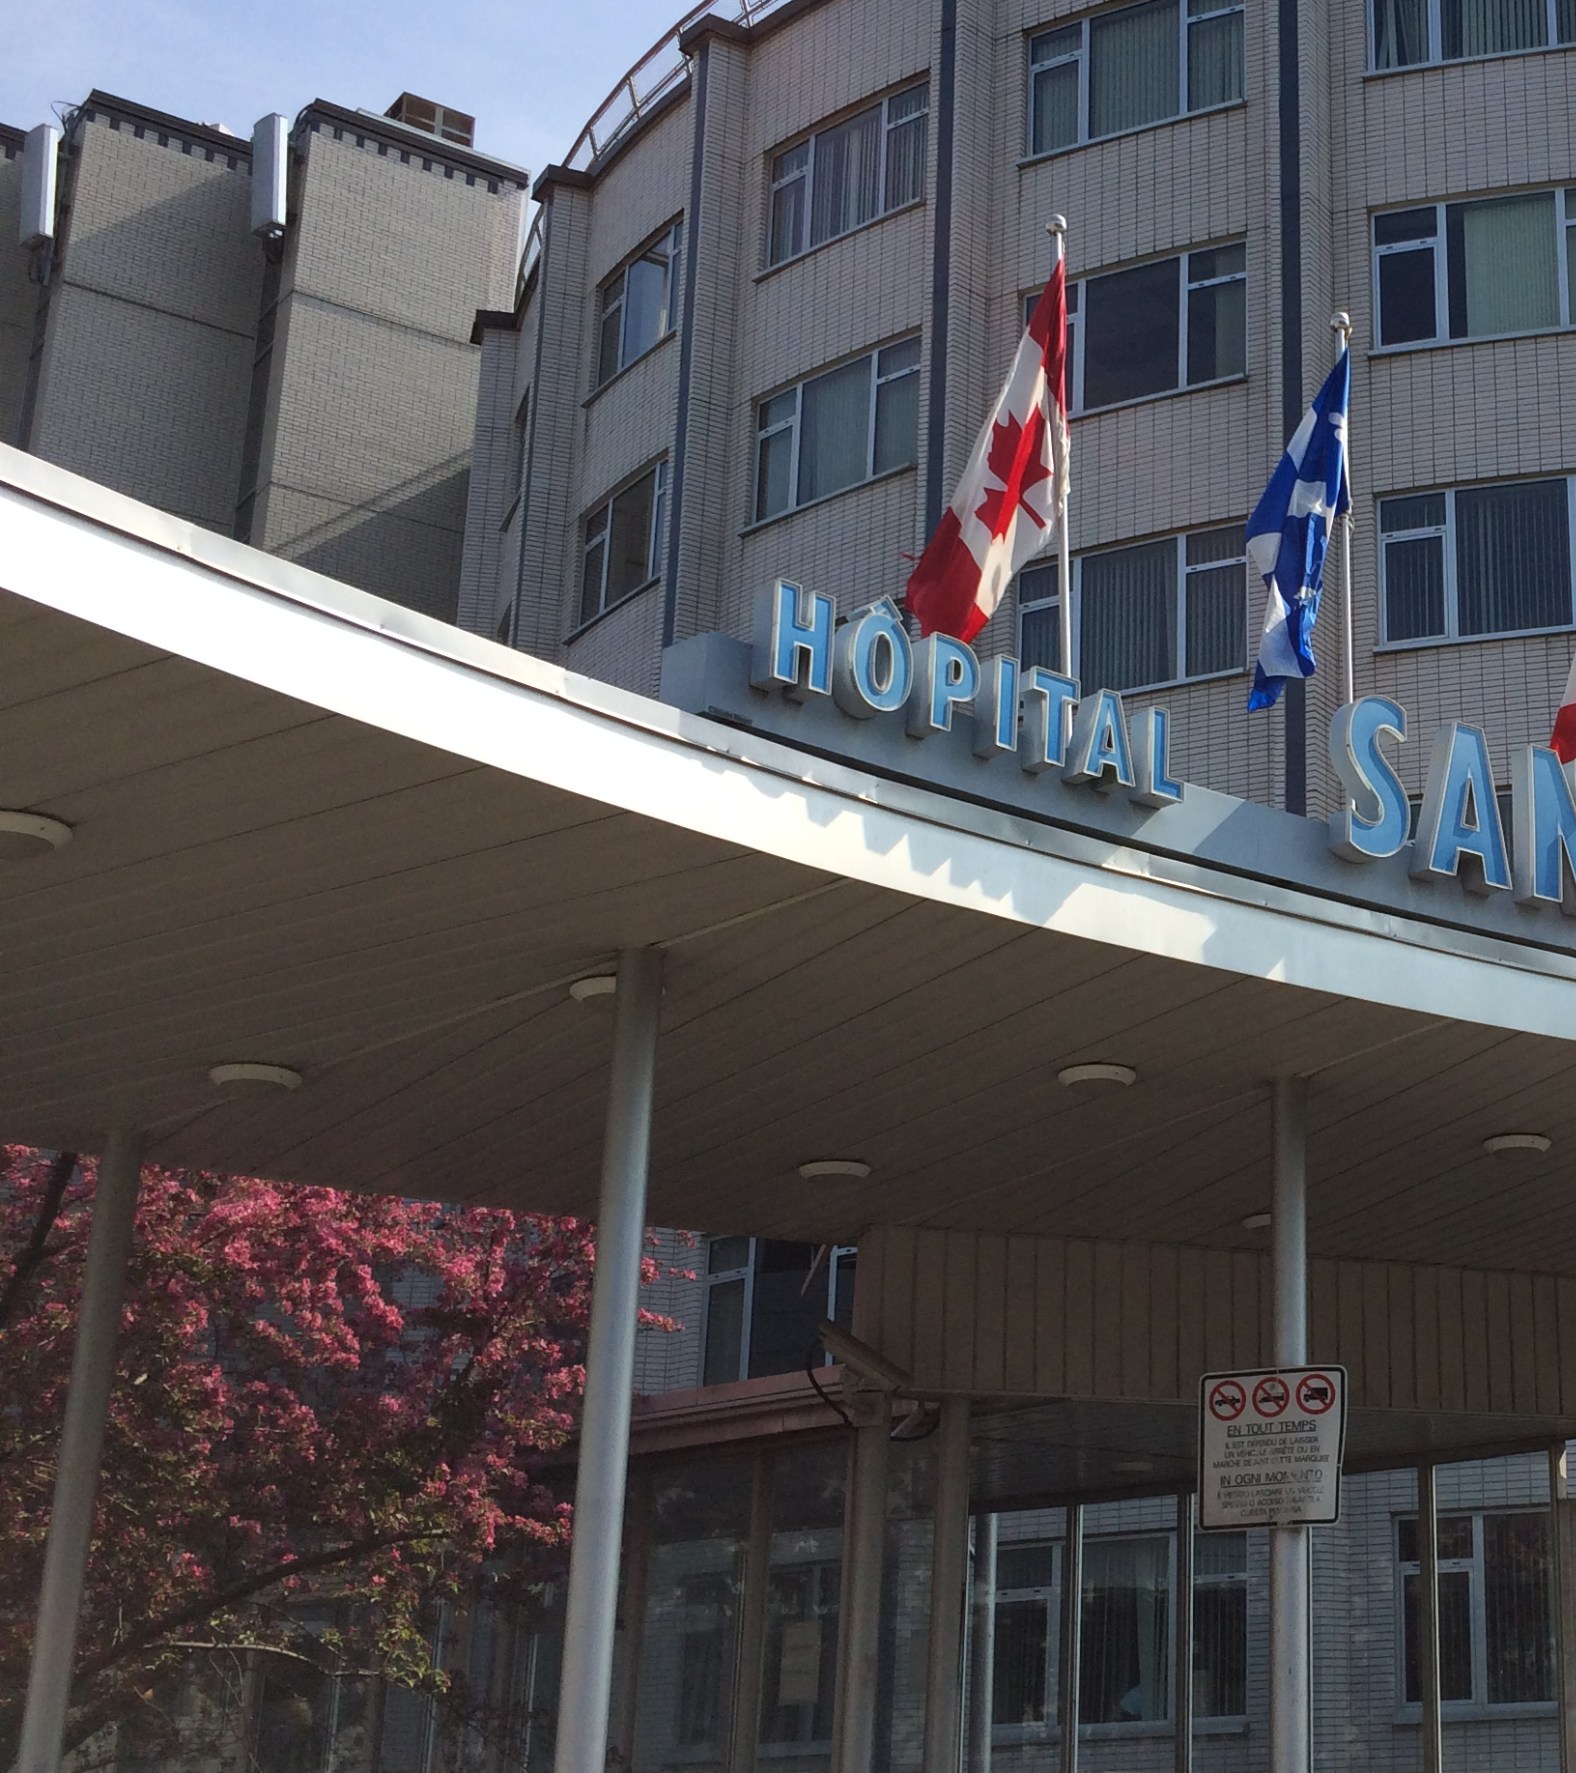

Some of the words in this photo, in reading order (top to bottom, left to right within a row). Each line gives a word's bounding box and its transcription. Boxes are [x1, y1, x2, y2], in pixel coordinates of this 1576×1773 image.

[770, 577, 1184, 803] HÔPITAL
[1227, 1425, 1241, 1435] EN
[1246, 1422, 1274, 1433] TOUT
[1279, 1420, 1316, 1432] TEMPS
[1220, 1475, 1231, 1485] IN
[1235, 1473, 1261, 1484] OGNI
